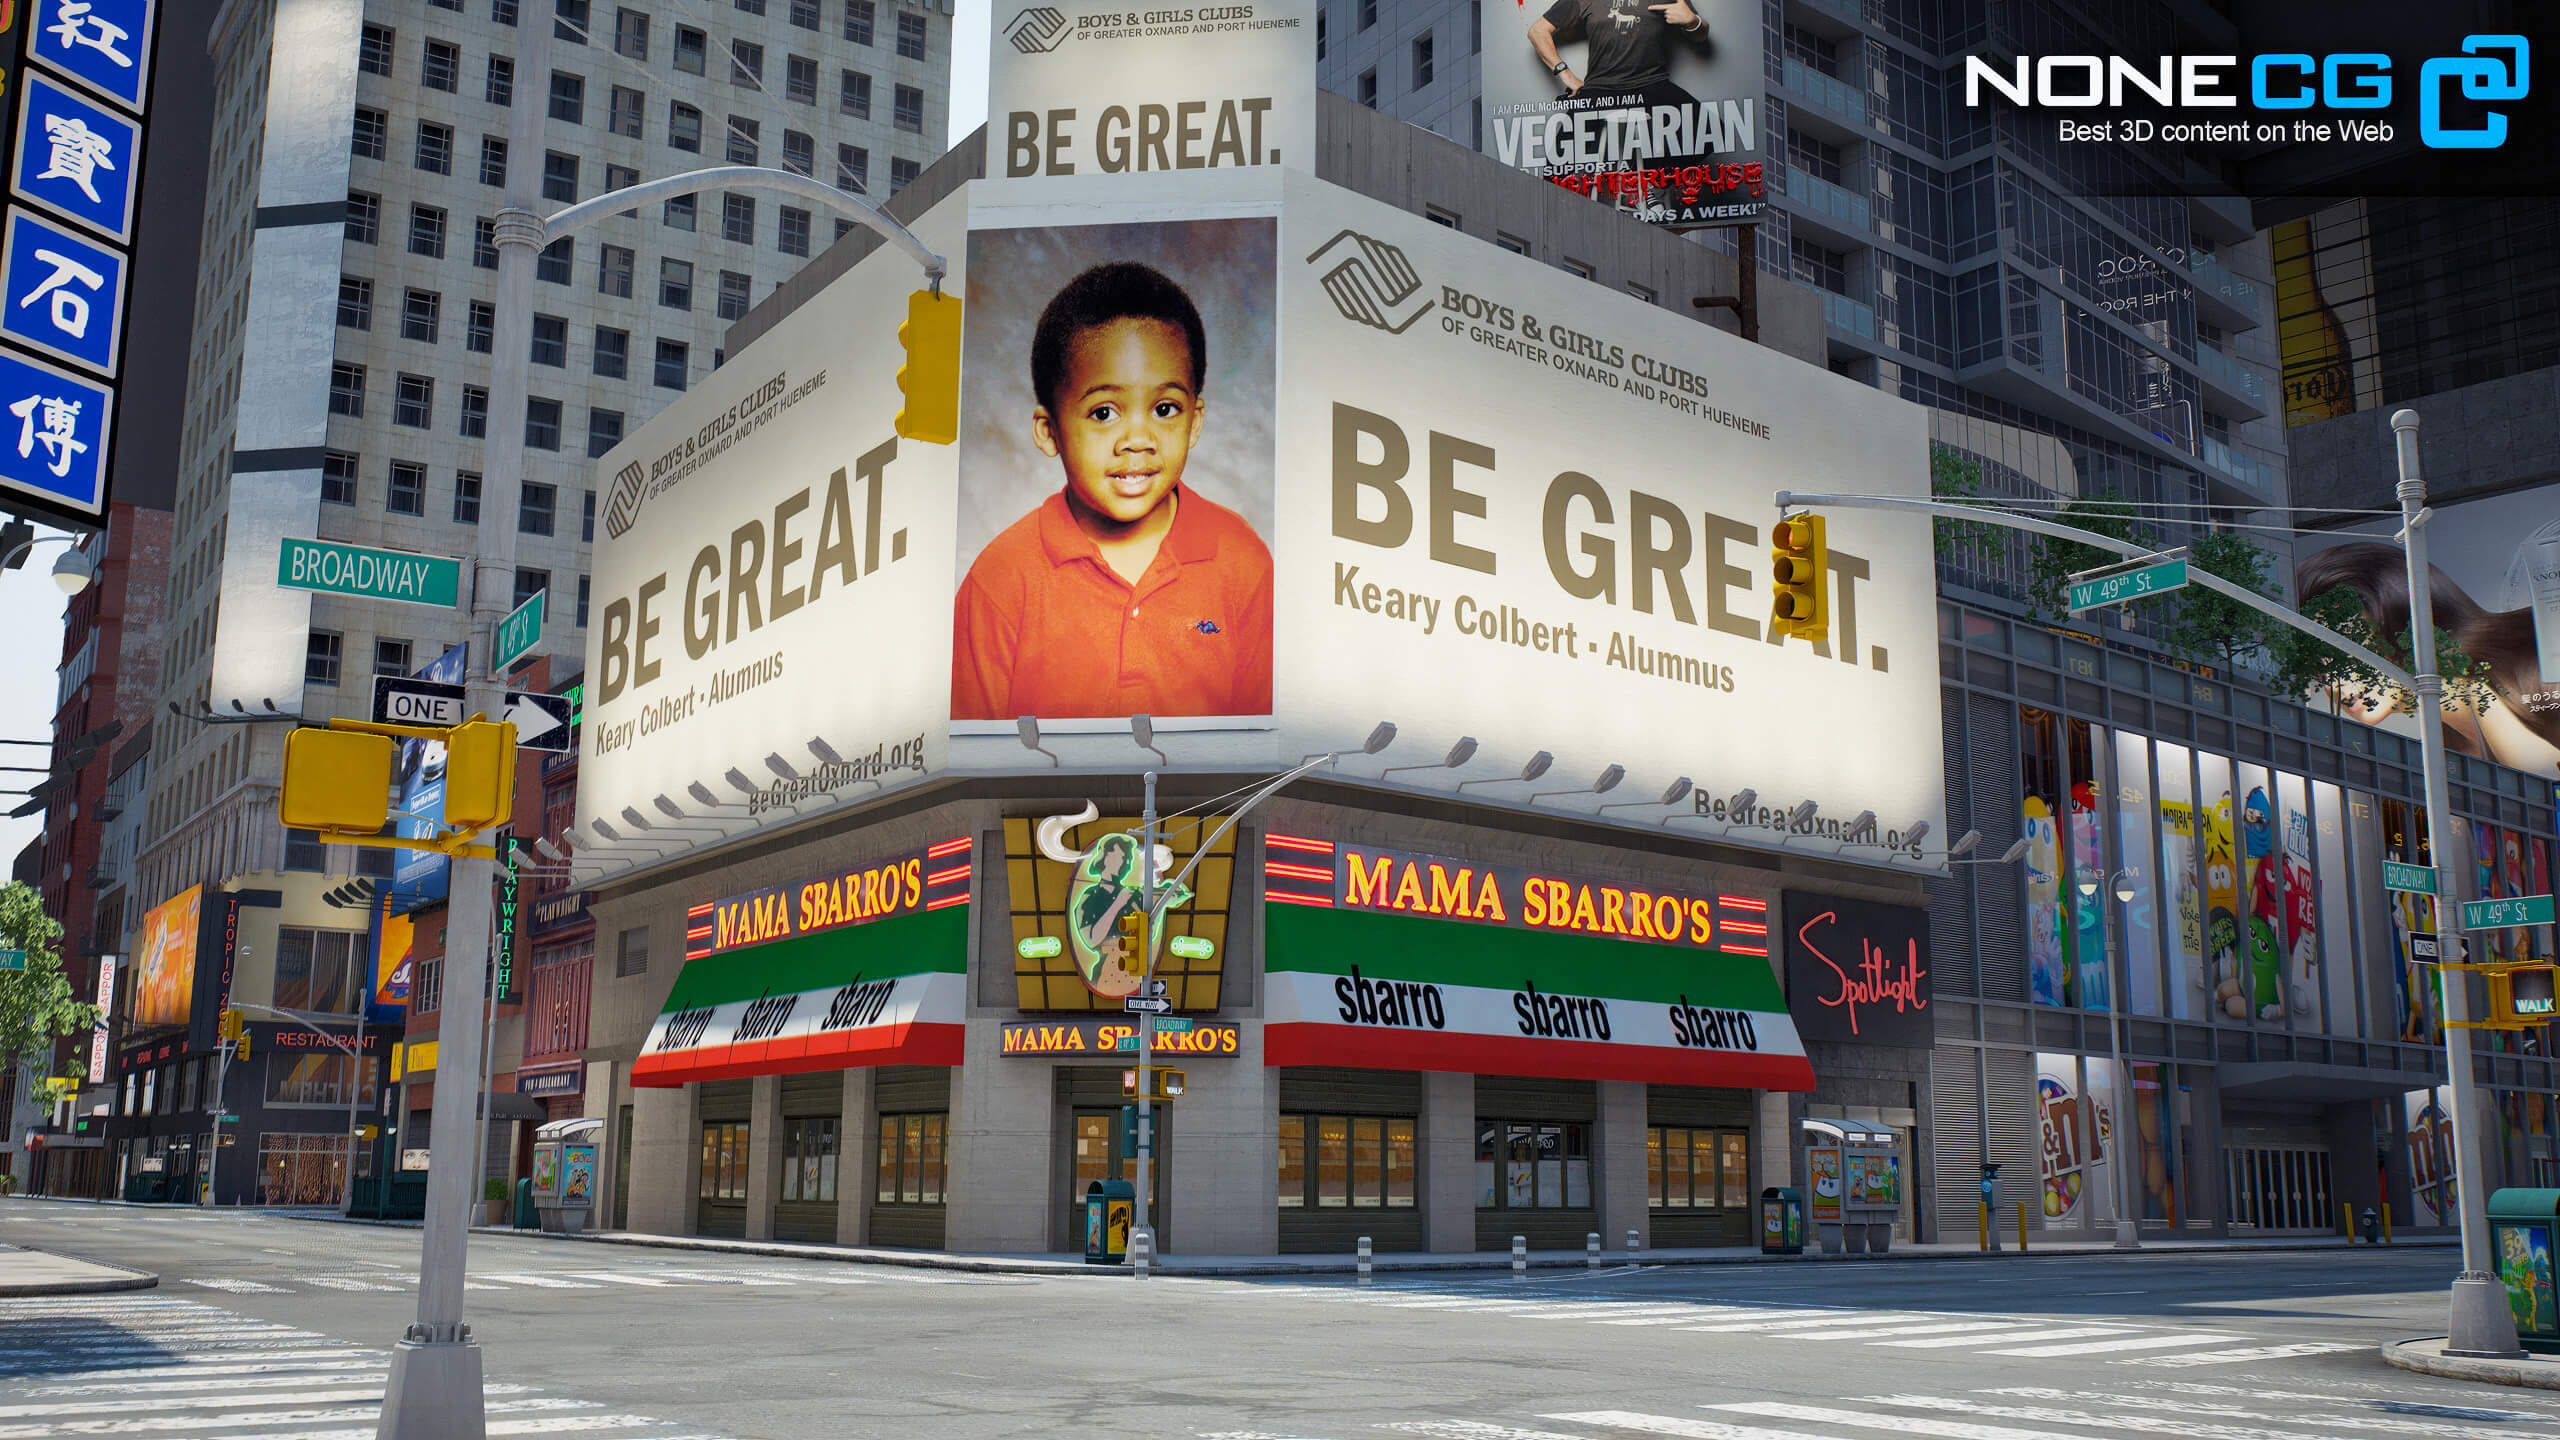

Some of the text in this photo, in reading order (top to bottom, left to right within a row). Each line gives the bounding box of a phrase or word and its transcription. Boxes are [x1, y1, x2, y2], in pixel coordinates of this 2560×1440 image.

[1077, 6, 1253, 29] BOYS & GIRLS CLUBS
[1077, 18, 1300, 41] OF GREATER OXNARD AND PORT HUENEME
[1493, 98, 1755, 169] VEGETARIAN
[1514, 104, 1536, 114] PAUL
[1596, 97, 1614, 107] AND
[1621, 95, 1636, 105] AM
[1636, 94, 1644, 104] A
[1006, 97, 1281, 179] BE GREAT.
[1543, 161, 1616, 177] SUPPORT
[1617, 160, 1630, 172] A
[1681, 209, 1695, 220] A
[1441, 285, 1709, 399] BOYS & GIRLS CLUBS
[1441, 316, 1771, 441] OF GREATER OXNARD AND PORT HUENEME
[649, 369, 827, 501] OF GREATER OXNARD AND PORT HUENEME
[651, 371, 786, 483] BOYS & GIRLS CLUBS
[1331, 401, 1889, 674] BE GRET.
[291, 546, 429, 597] BROADWAY
[598, 435, 908, 707] BE GREAT.
[2077, 572, 2152, 605] W 49th St
[1334, 561, 1736, 695] Keary Colbert Alumnus
[395, 695, 449, 721] ONE
[595, 713, 636, 757] Keary
[640, 684, 695, 738] Colbert
[708, 650, 784, 708] Alumnus
[715, 858, 921, 950] MAMA SBARRO'S
[1346, 853, 1714, 945] MAMA SBARRO'S
[2387, 865, 2427, 889] BROADWAY
[221, 899, 237, 984] TROPIC
[499, 838, 518, 1000] PLAYWRIGHT
[2468, 901, 2529, 925] W 49th St
[1799, 911, 1927, 1035] Spotlight
[2416, 941, 2435, 955] ONE
[657, 1000, 718, 1051] sbarro
[733, 986, 800, 1042] sbarro
[820, 971, 899, 1031] sbarro
[1335, 965, 1444, 1030] sbarro
[1514, 980, 1610, 1042] sbarro
[1670, 995, 1756, 1051] sbarro
[2515, 998, 2555, 1014] WALK
[275, 1032, 377, 1049] RESTAURANT
[1003, 1026, 1085, 1053] MAMA
